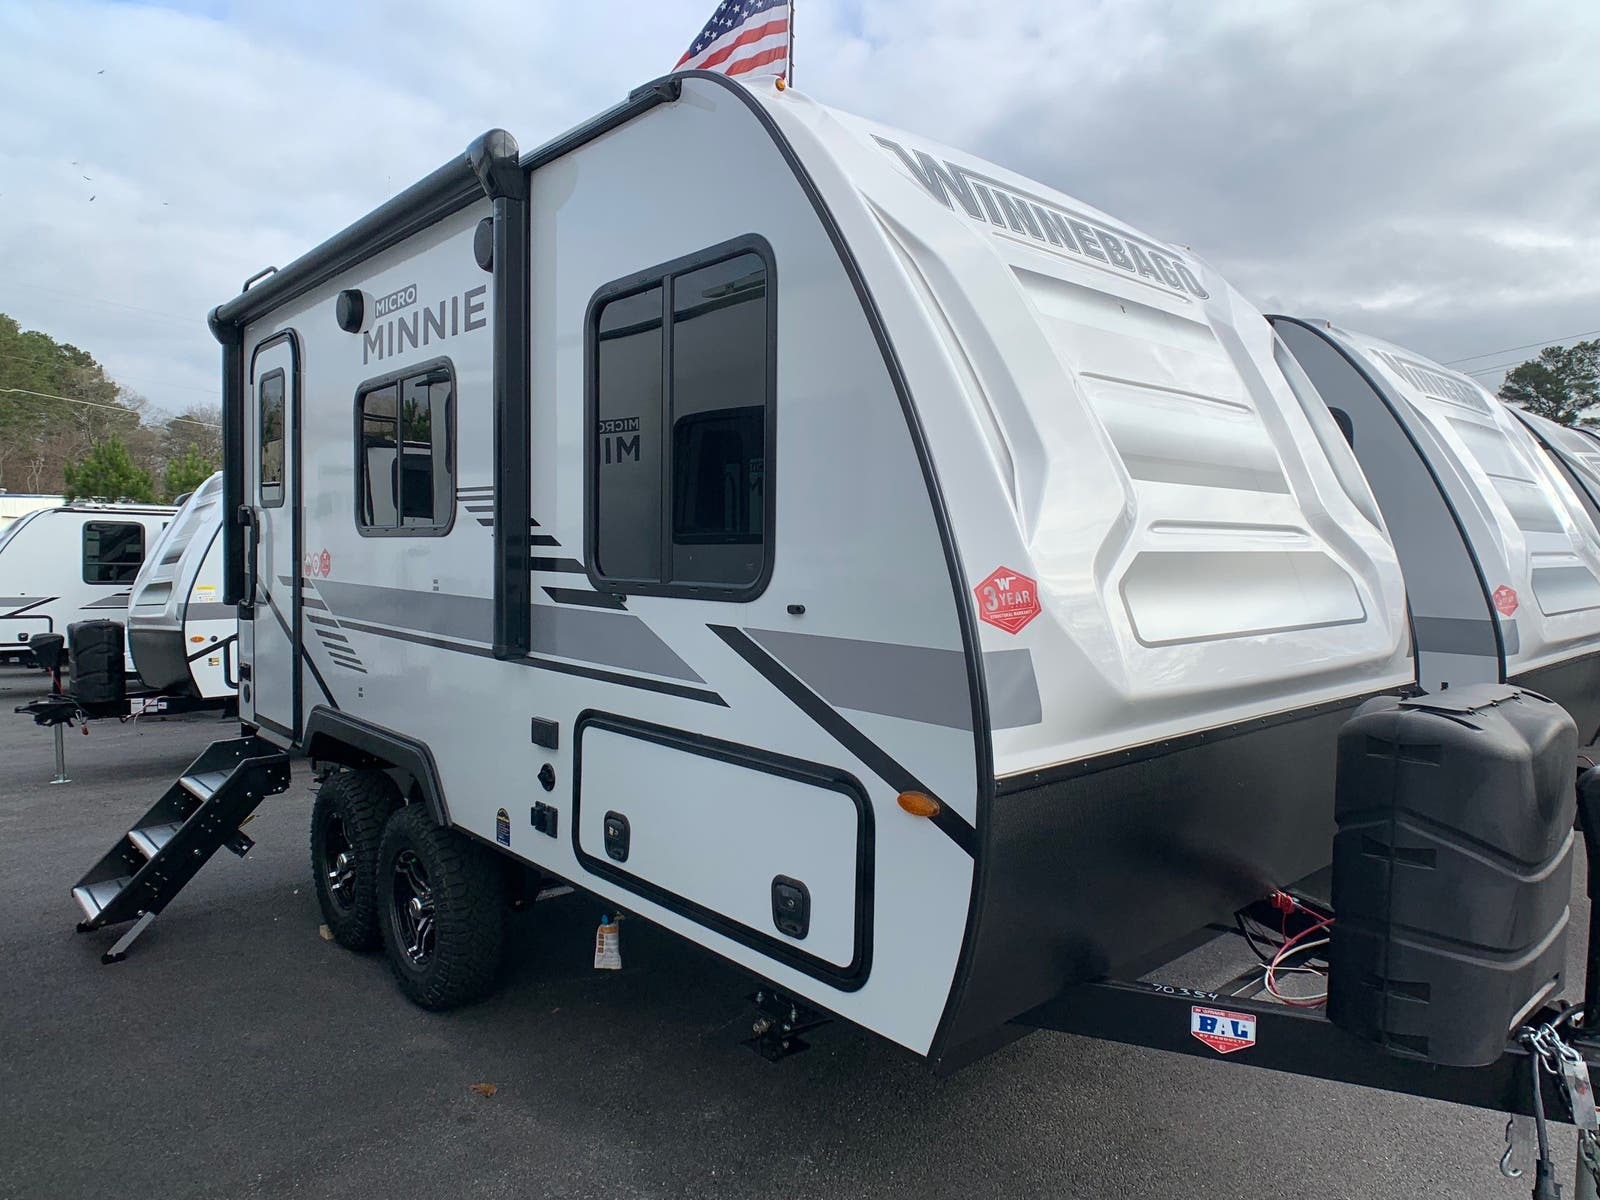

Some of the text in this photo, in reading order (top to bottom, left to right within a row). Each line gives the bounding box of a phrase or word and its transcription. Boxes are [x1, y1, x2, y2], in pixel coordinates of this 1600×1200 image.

[870, 133, 1209, 300] WINNEBAGO
[363, 284, 487, 365] MINNIE
[376, 287, 416, 316] MICRO
[1368, 348, 1494, 414] WINNEB
[983, 586, 1031, 612] 3 YEAR
[1199, 1015, 1248, 1039] BAL
